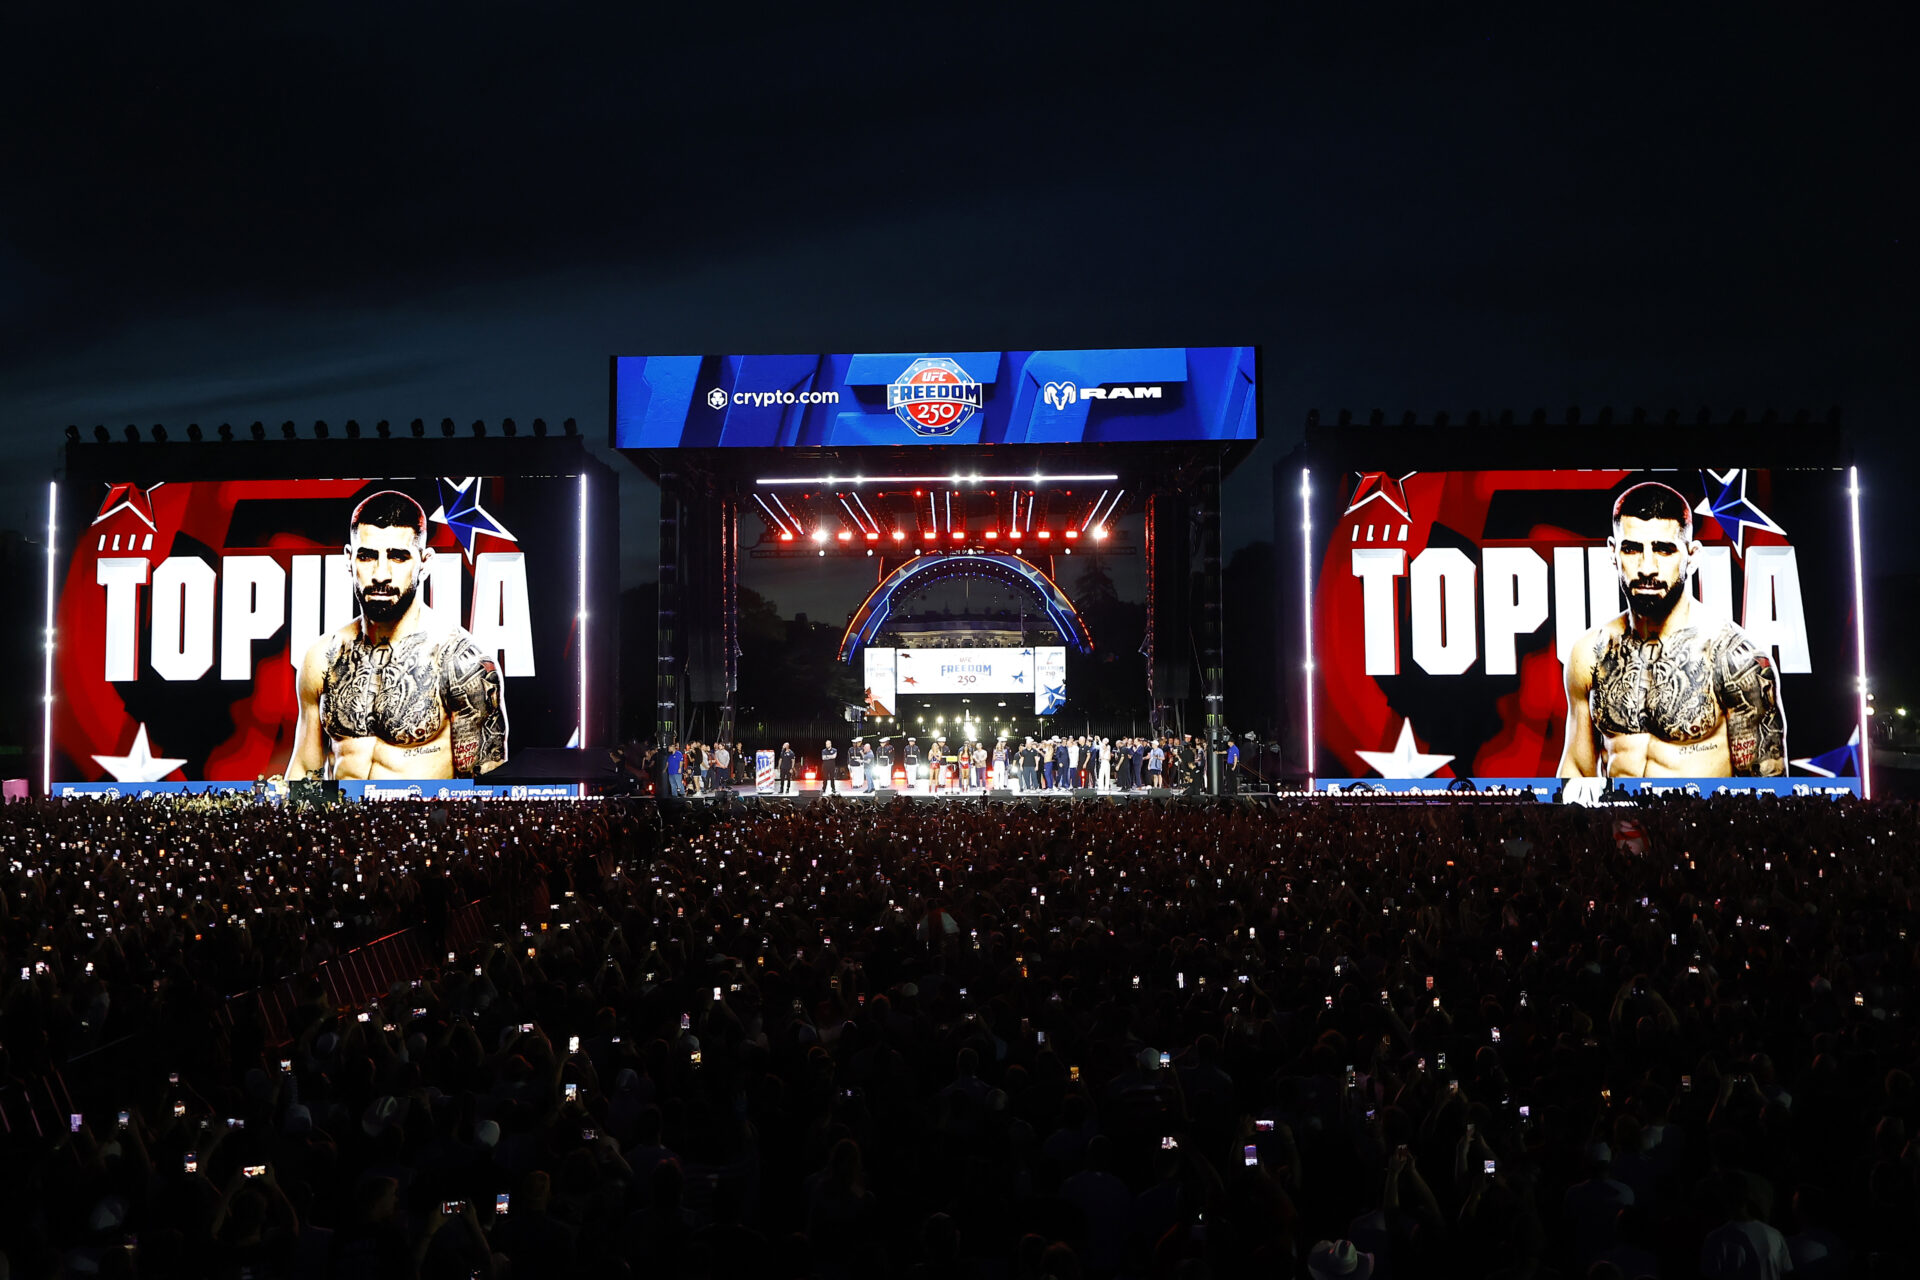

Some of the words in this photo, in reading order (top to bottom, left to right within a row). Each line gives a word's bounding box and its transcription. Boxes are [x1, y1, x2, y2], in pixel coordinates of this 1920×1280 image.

[921, 371, 948, 382] UFC
[733, 389, 840, 407] crypto.com
[888, 384, 982, 410] FREEDOM
[1079, 386, 1162, 400] RAM
[917, 403, 955, 424] 250
[97, 533, 154, 551] ILIA
[1351, 524, 1409, 542] ILIA
[96, 551, 536, 682] TOPUIA
[1351, 545, 1813, 676] TOPUIA
